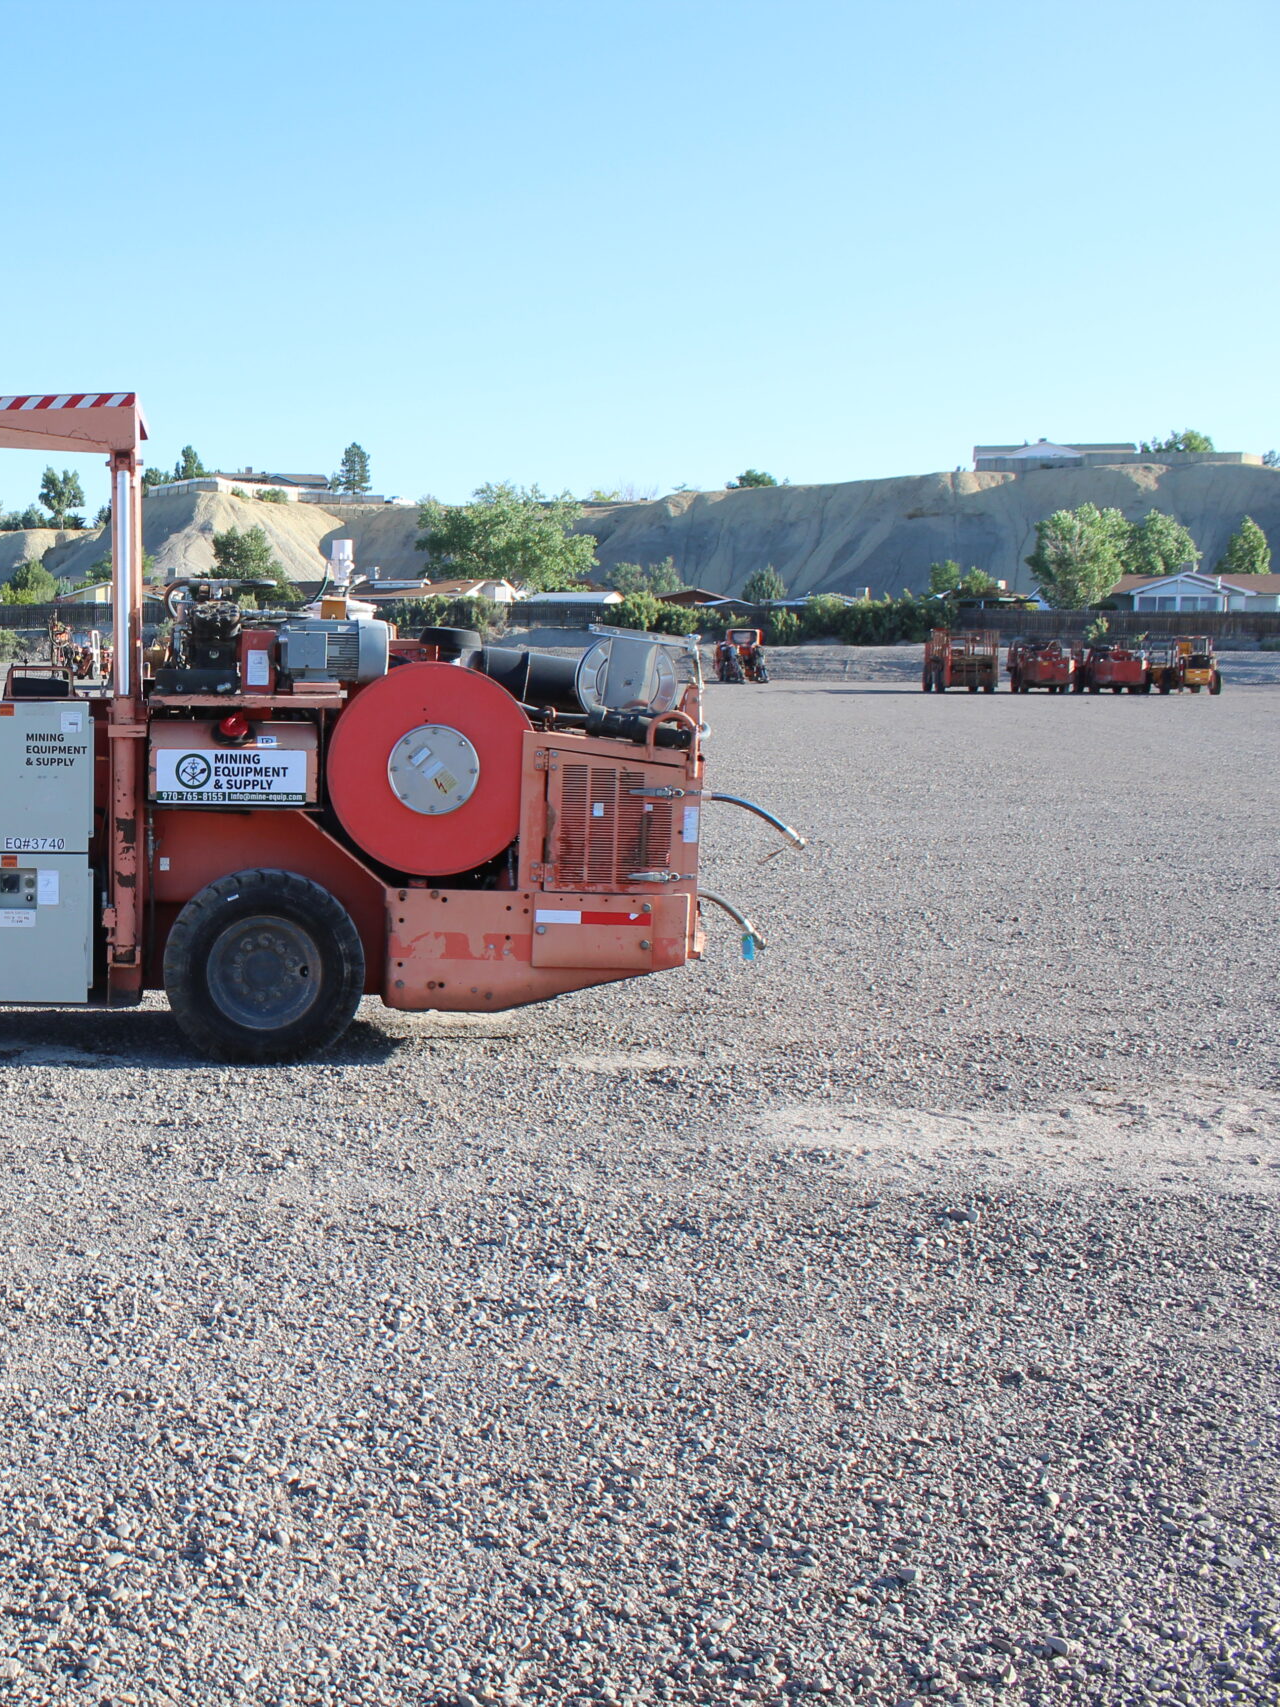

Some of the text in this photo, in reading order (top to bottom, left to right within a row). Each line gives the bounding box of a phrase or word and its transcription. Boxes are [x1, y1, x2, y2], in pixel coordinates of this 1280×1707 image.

[25, 733, 65, 743] MINING
[25, 745, 88, 755] EQUIPMENT
[25, 757, 75, 767] & SUPPLY
[214, 753, 261, 765] MINING
[214, 766, 289, 778] EQUIPMENT
[213, 779, 273, 790] & SUPPLY
[161, 791, 224, 801] 970-765-8155
[5, 837, 65, 850] EQ#3740
